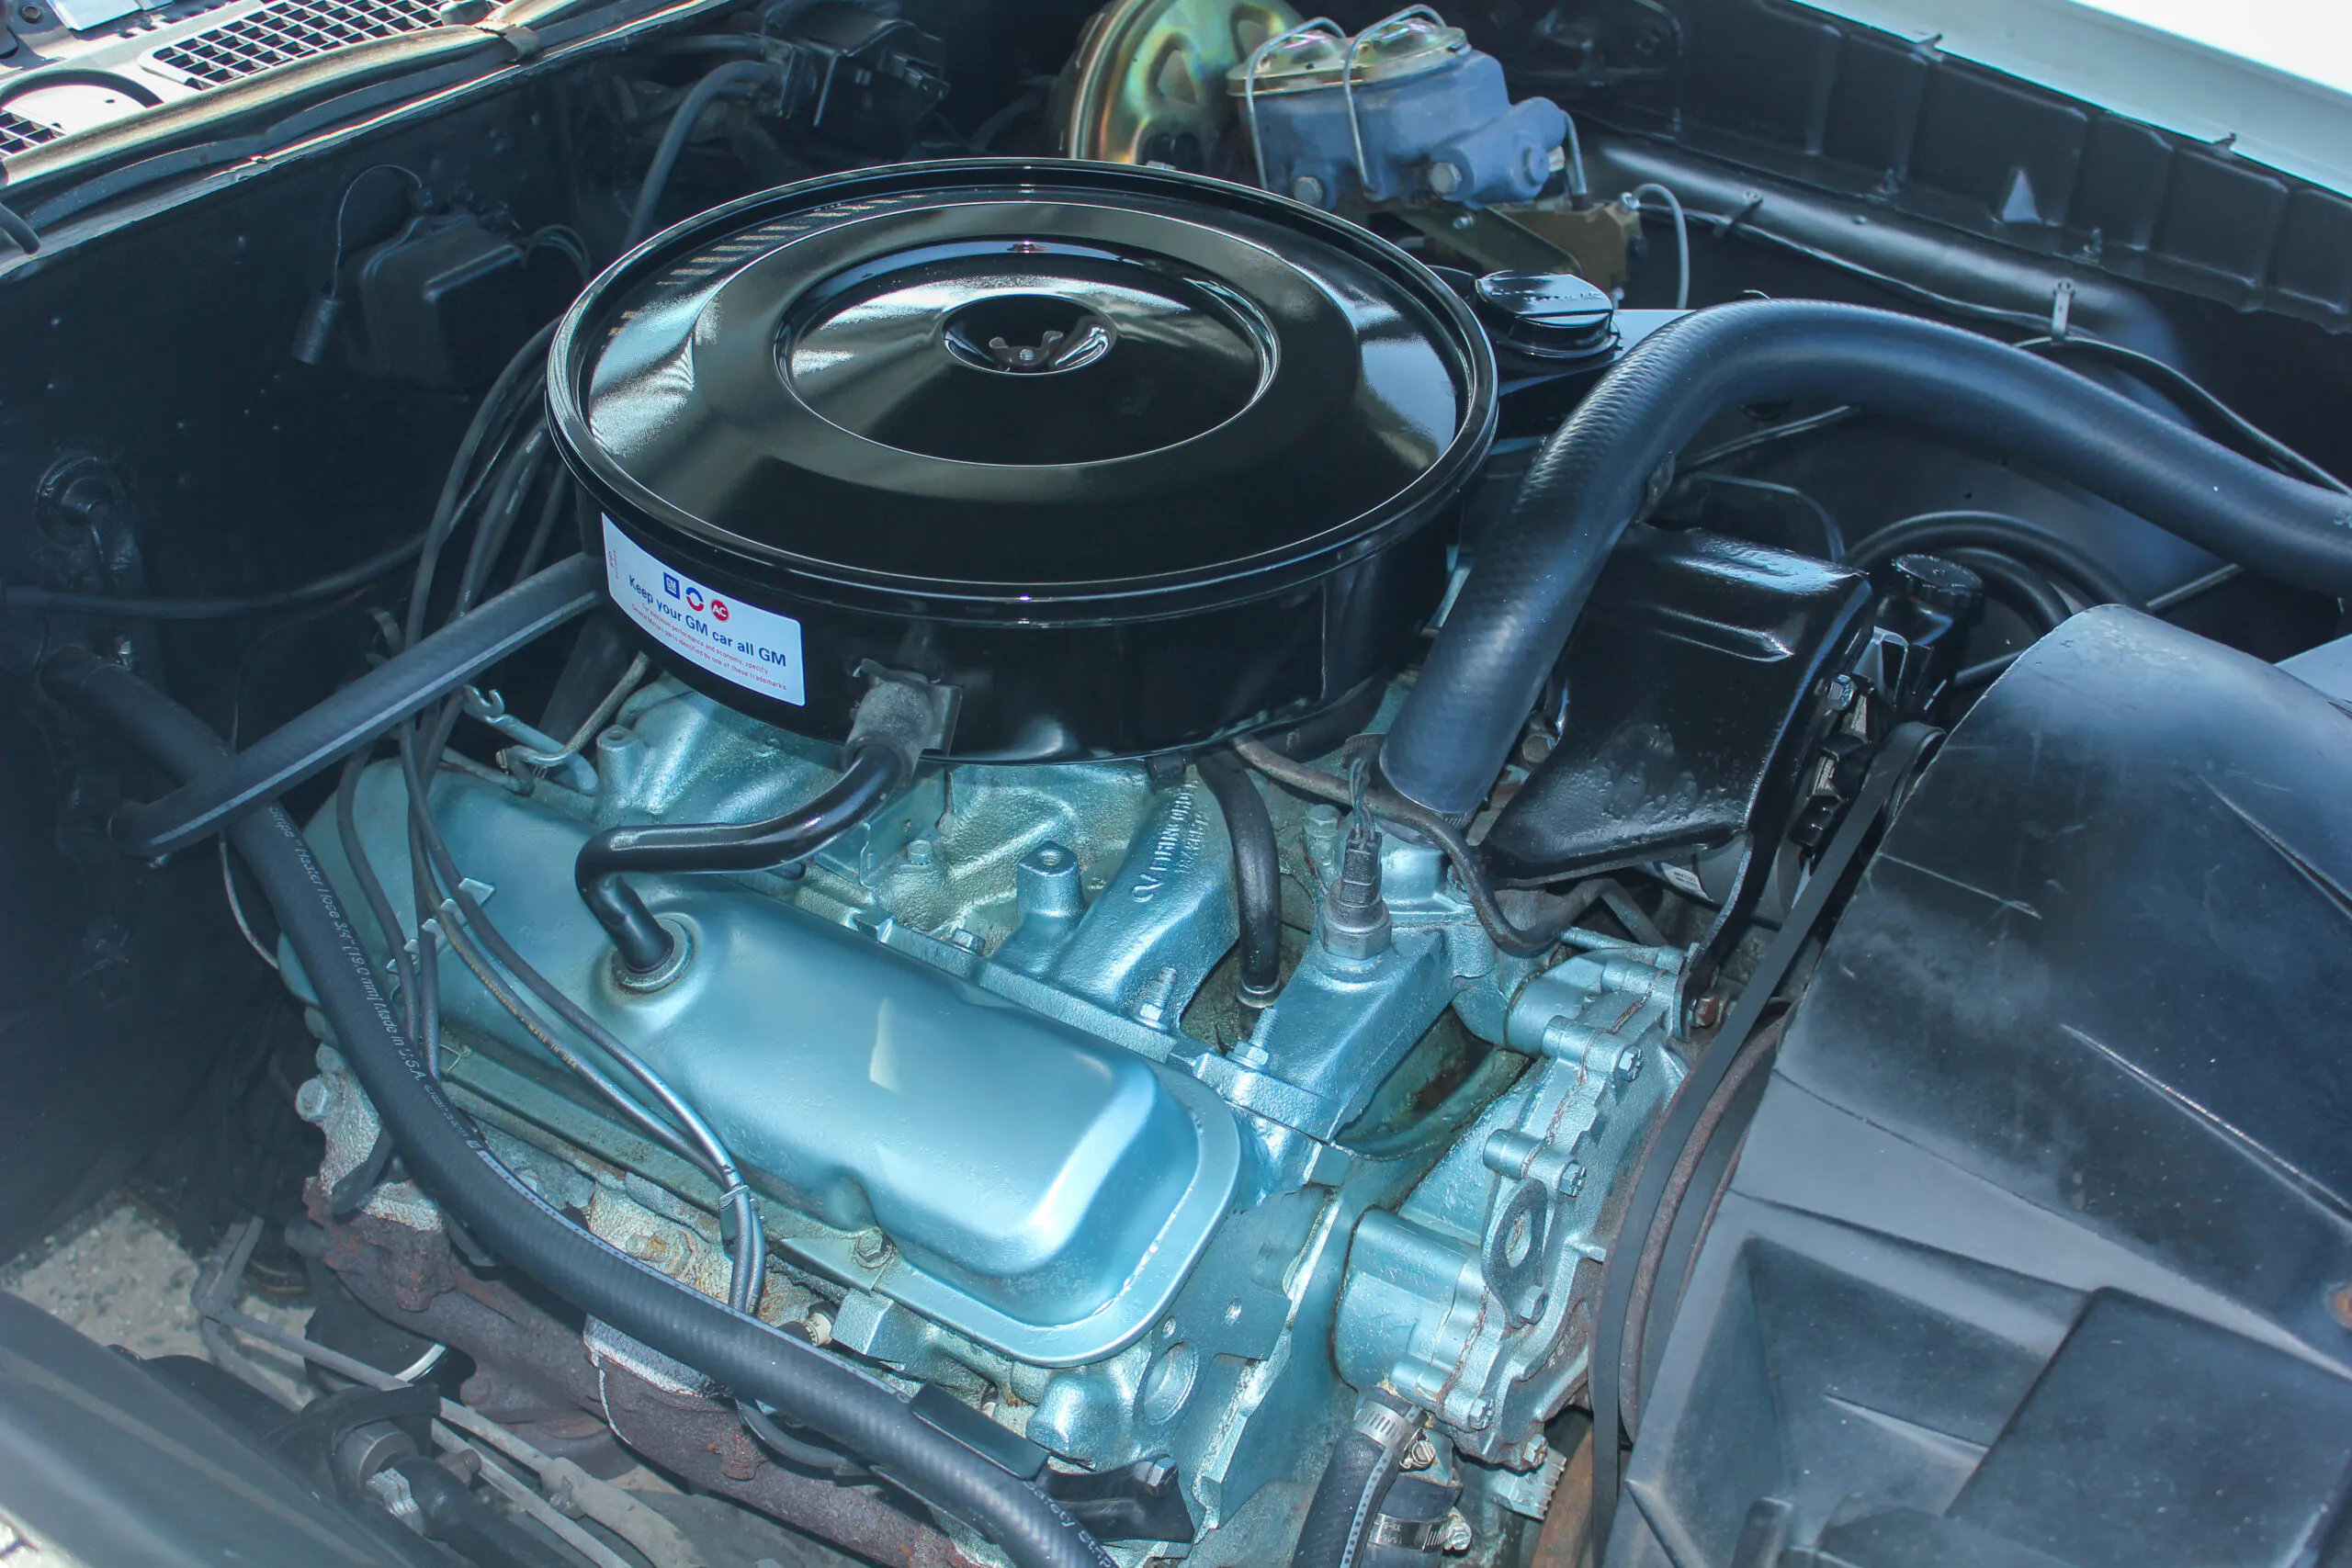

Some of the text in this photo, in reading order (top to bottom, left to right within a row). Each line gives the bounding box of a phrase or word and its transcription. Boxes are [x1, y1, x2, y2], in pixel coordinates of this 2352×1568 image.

[629, 575, 786, 667] Keep your GM car all GM
[712, 604, 729, 618] AC
[665, 630, 678, 642] parts
[679, 638, 704, 657] identified
[704, 651, 711, 660] by
[712, 657, 723, 666] one
[731, 665, 749, 677] these
[750, 672, 786, 691] trademarks
[672, 626, 705, 648] performance
[706, 644, 716, 653] and
[716, 649, 744, 666] economy,
[745, 661, 768, 675] specify
[268, 806, 296, 838] Stripe
[294, 848, 325, 886] Heater
[373, 1002, 398, 1033] Made
[1078, 1530, 1116, 1568] Strip
